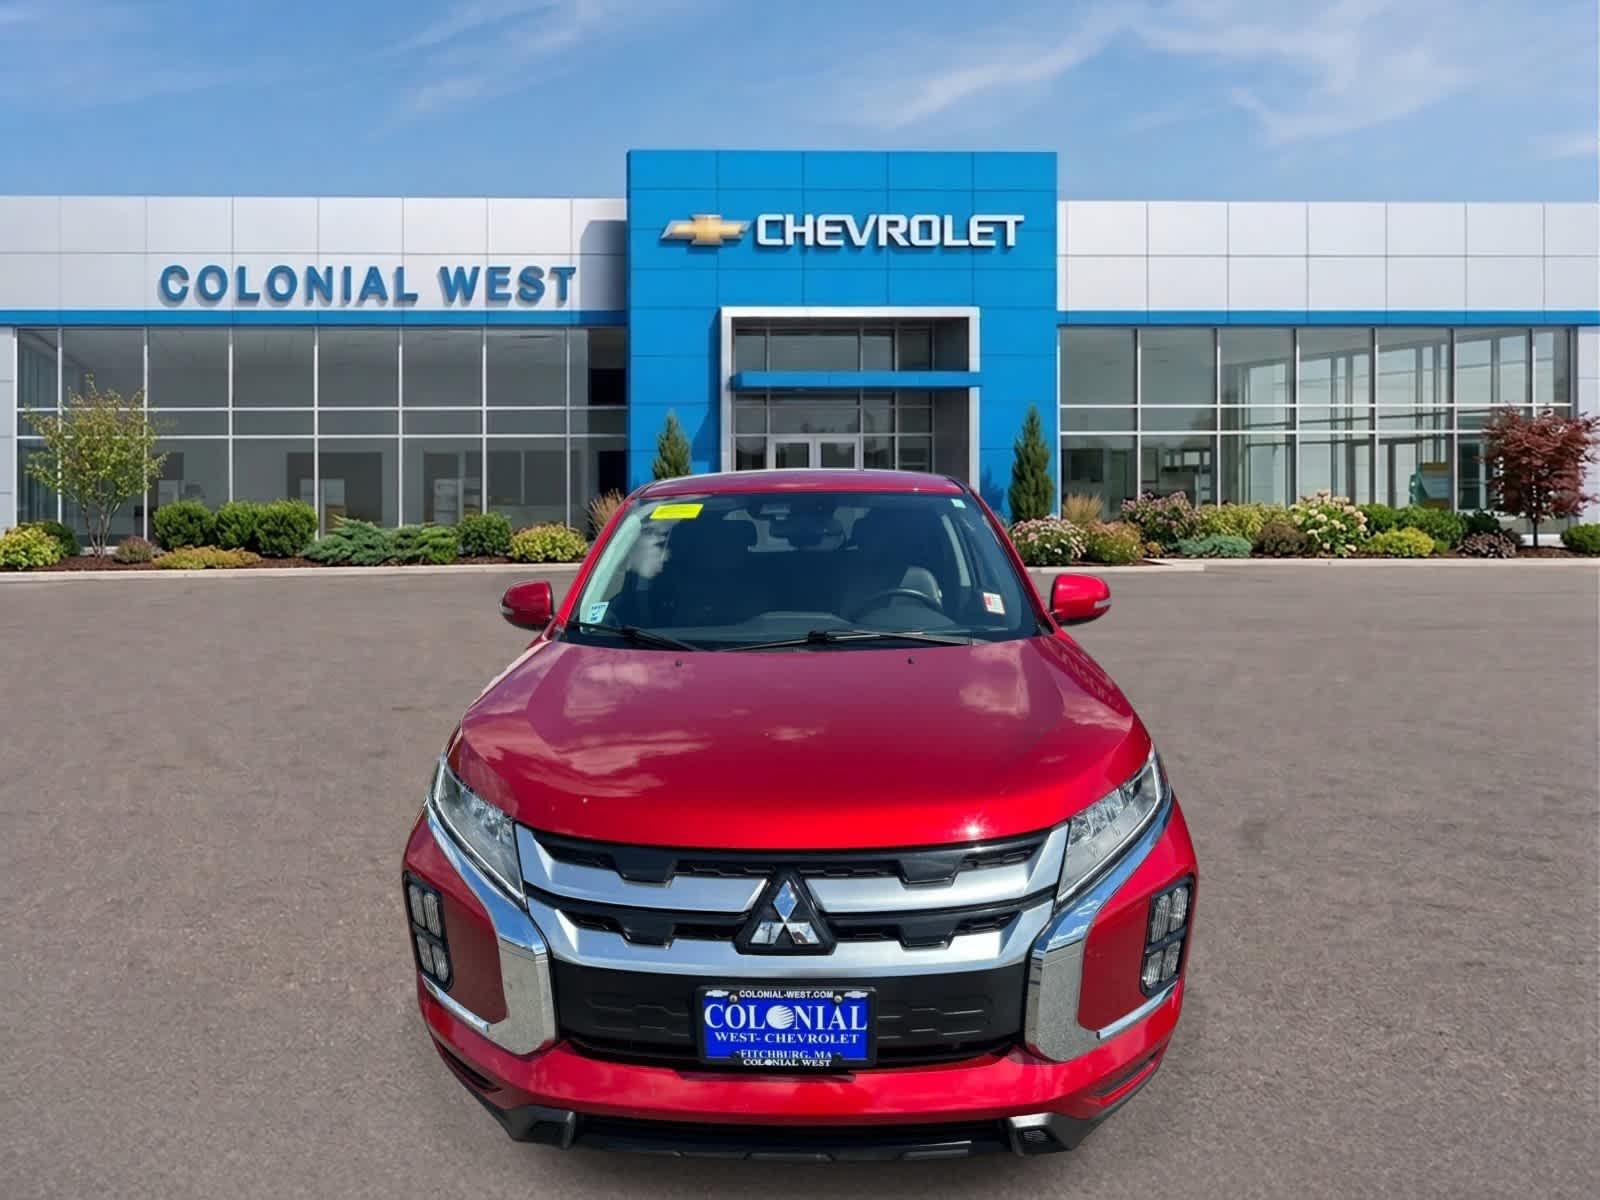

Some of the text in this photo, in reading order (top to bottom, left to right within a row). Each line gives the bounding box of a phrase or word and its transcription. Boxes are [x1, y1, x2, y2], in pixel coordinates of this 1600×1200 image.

[757, 214, 1025, 248] CHEVROLET
[159, 264, 577, 305] COLONIAL WEST
[739, 990, 833, 999] COLONIAL-WEST.COM
[704, 1003, 868, 1031] COLONIAL
[764, 1032, 860, 1044] CHEVROLET
[814, 1050, 832, 1059] MA
[743, 1059, 832, 1067] COLONIAL WEST
